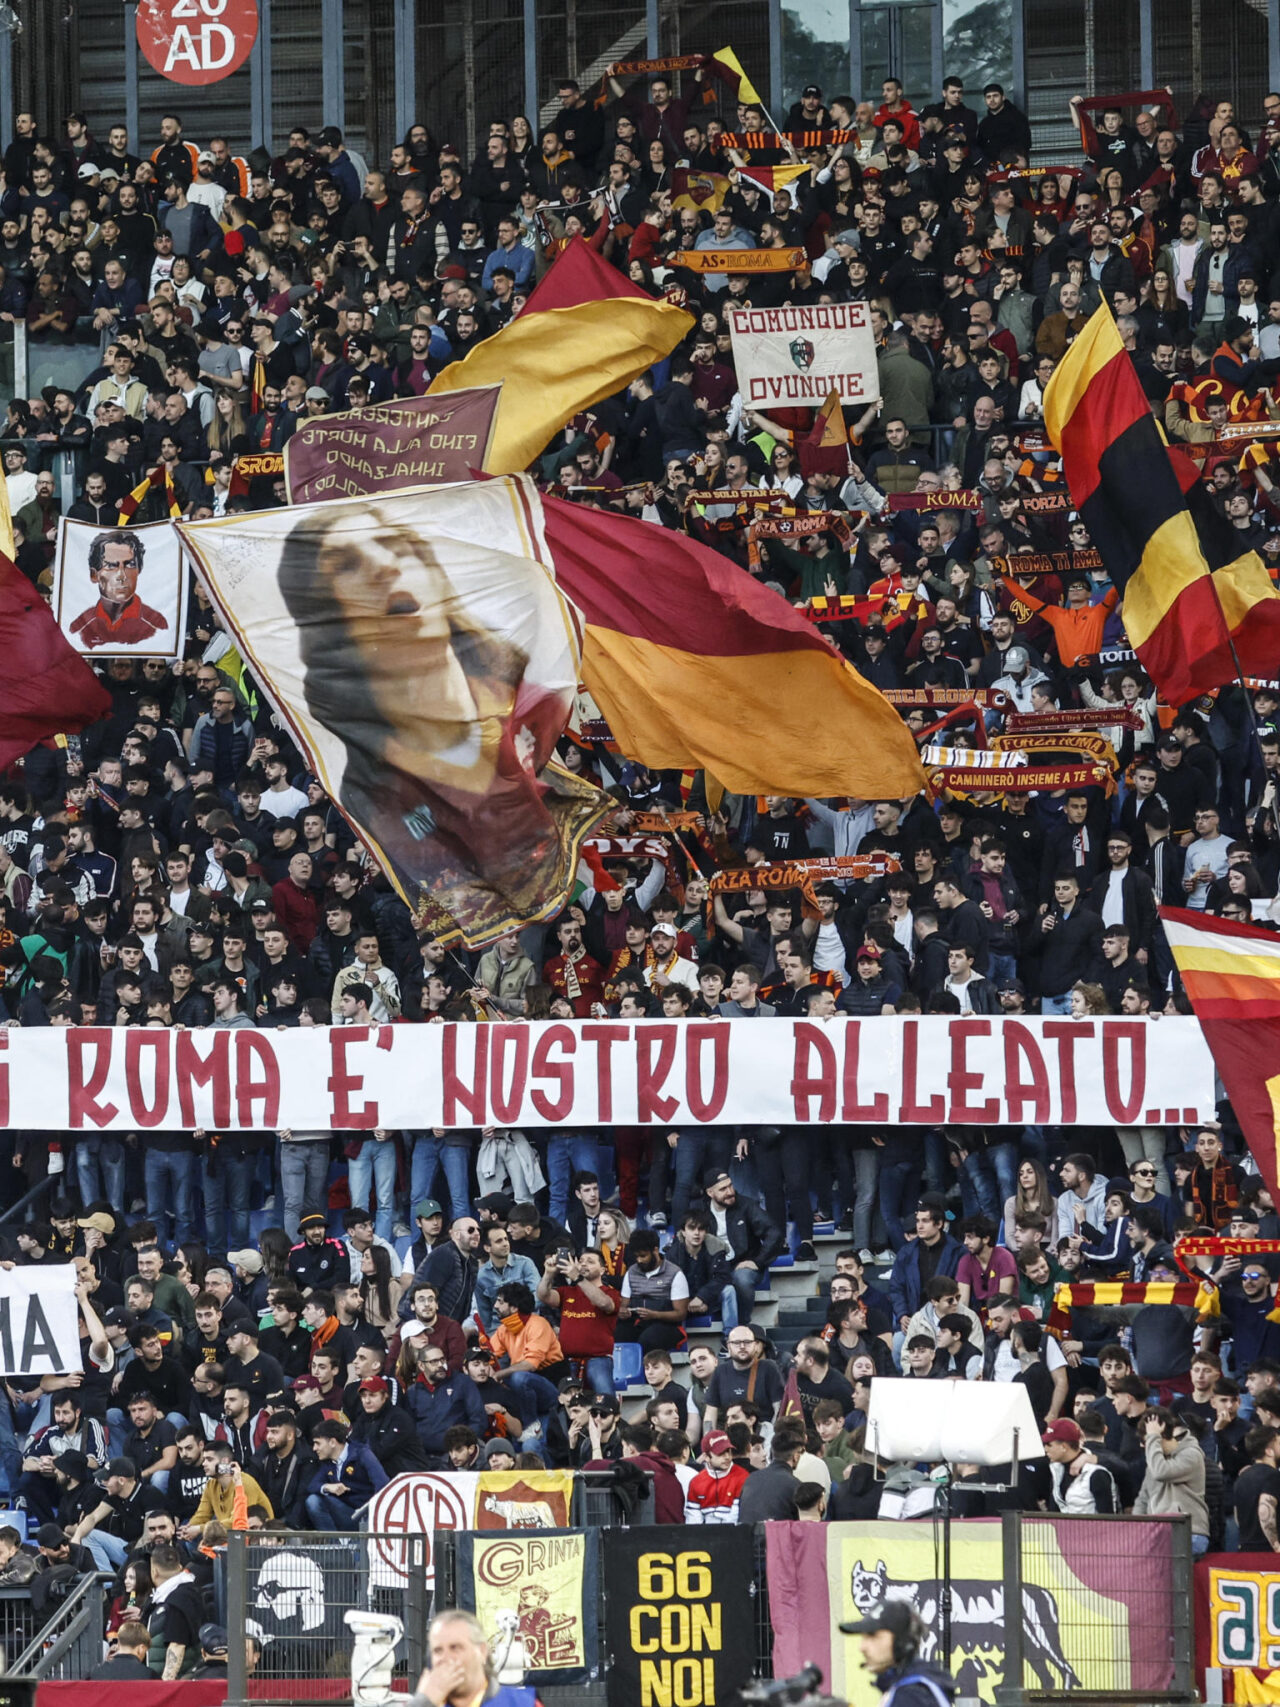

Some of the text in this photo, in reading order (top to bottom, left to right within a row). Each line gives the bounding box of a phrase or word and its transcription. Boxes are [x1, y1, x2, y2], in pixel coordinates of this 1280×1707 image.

[163, 25, 234, 71] AD
[700, 253, 773, 267] AS ROMA
[732, 304, 866, 334] COMUNQUE
[749, 372, 865, 401] OVUNQUE
[713, 490, 739, 499] SOLO
[926, 490, 980, 508] ROMA
[1023, 495, 1066, 511] FORZA
[791, 515, 827, 531] ROMA
[1011, 553, 1053, 572] ROMA
[948, 770, 1087, 787] CAMMINERÒ INSIEME A TE
[66, 1027, 281, 1129] ROMA
[328, 1024, 393, 1131] E'
[443, 1022, 731, 1126] NOSTRO
[478, 1537, 581, 1588] GRINTA
[637, 1551, 713, 1600] 66
[629, 1602, 723, 1654] CON
[640, 1658, 716, 1707] NOI
